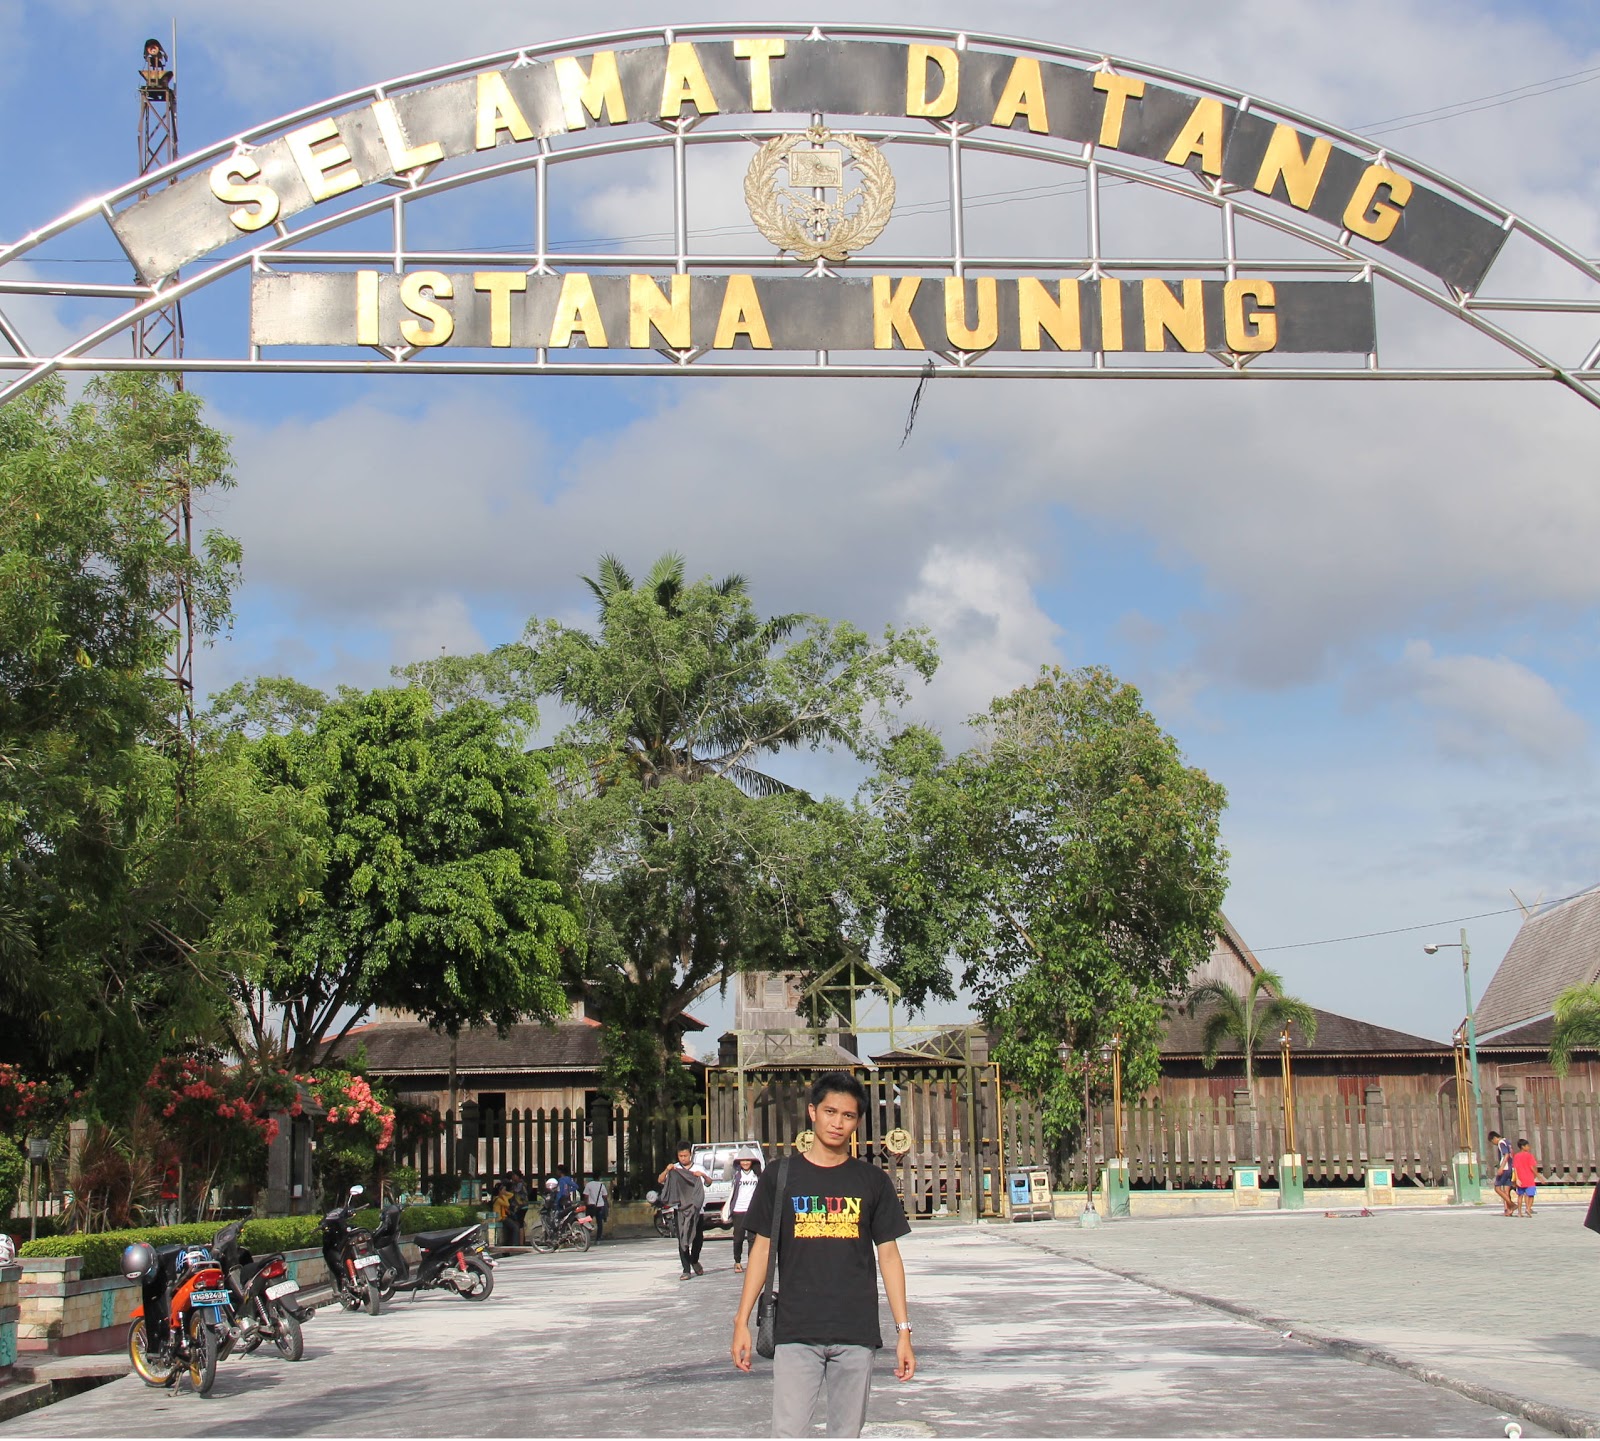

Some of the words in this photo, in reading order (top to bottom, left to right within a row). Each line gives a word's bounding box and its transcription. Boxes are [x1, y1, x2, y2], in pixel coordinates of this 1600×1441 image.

[209, 38, 786, 232] SELAMAT
[905, 44, 1414, 244] DATANG
[356, 270, 773, 349] ISTANA
[872, 275, 1279, 353] KUNING
[791, 1196, 861, 1214] ULUN
[795, 1212, 826, 1223] URANG
